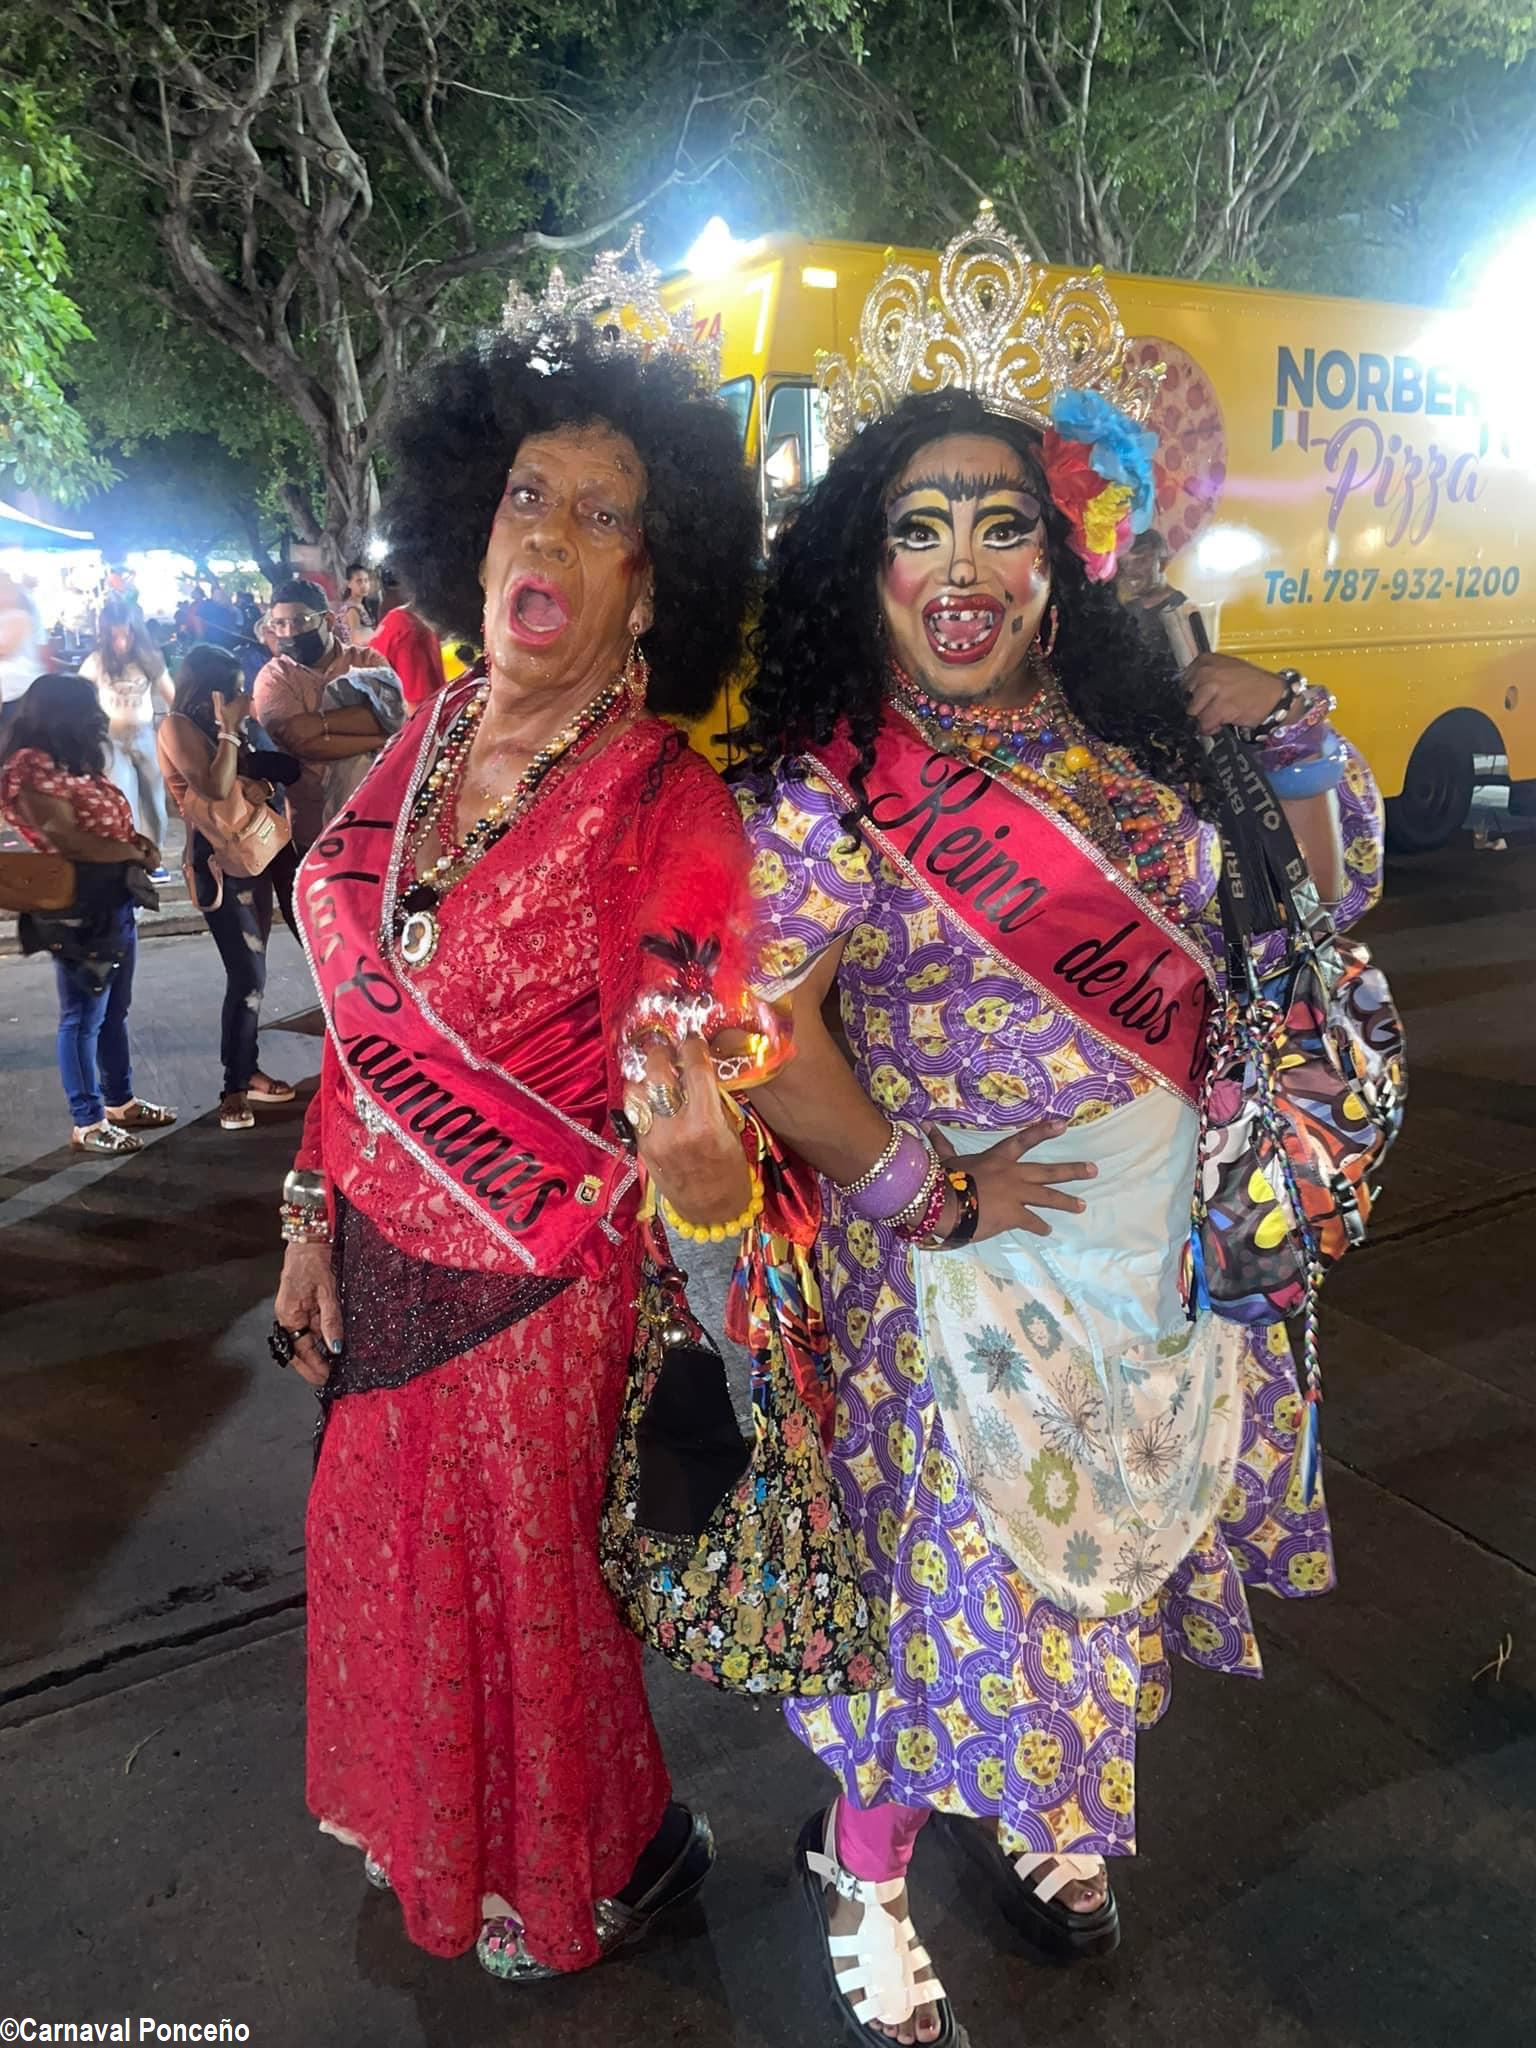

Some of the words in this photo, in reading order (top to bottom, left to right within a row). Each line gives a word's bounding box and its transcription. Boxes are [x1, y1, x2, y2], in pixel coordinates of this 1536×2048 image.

[1310, 418, 1488, 548] Pizza
[1264, 569, 1313, 605] Tel.
[1322, 566, 1520, 603] 787-932-1200
[868, 752, 1048, 934] Reina
[1053, 920, 1140, 998] de
[1108, 948, 1180, 1045] los
